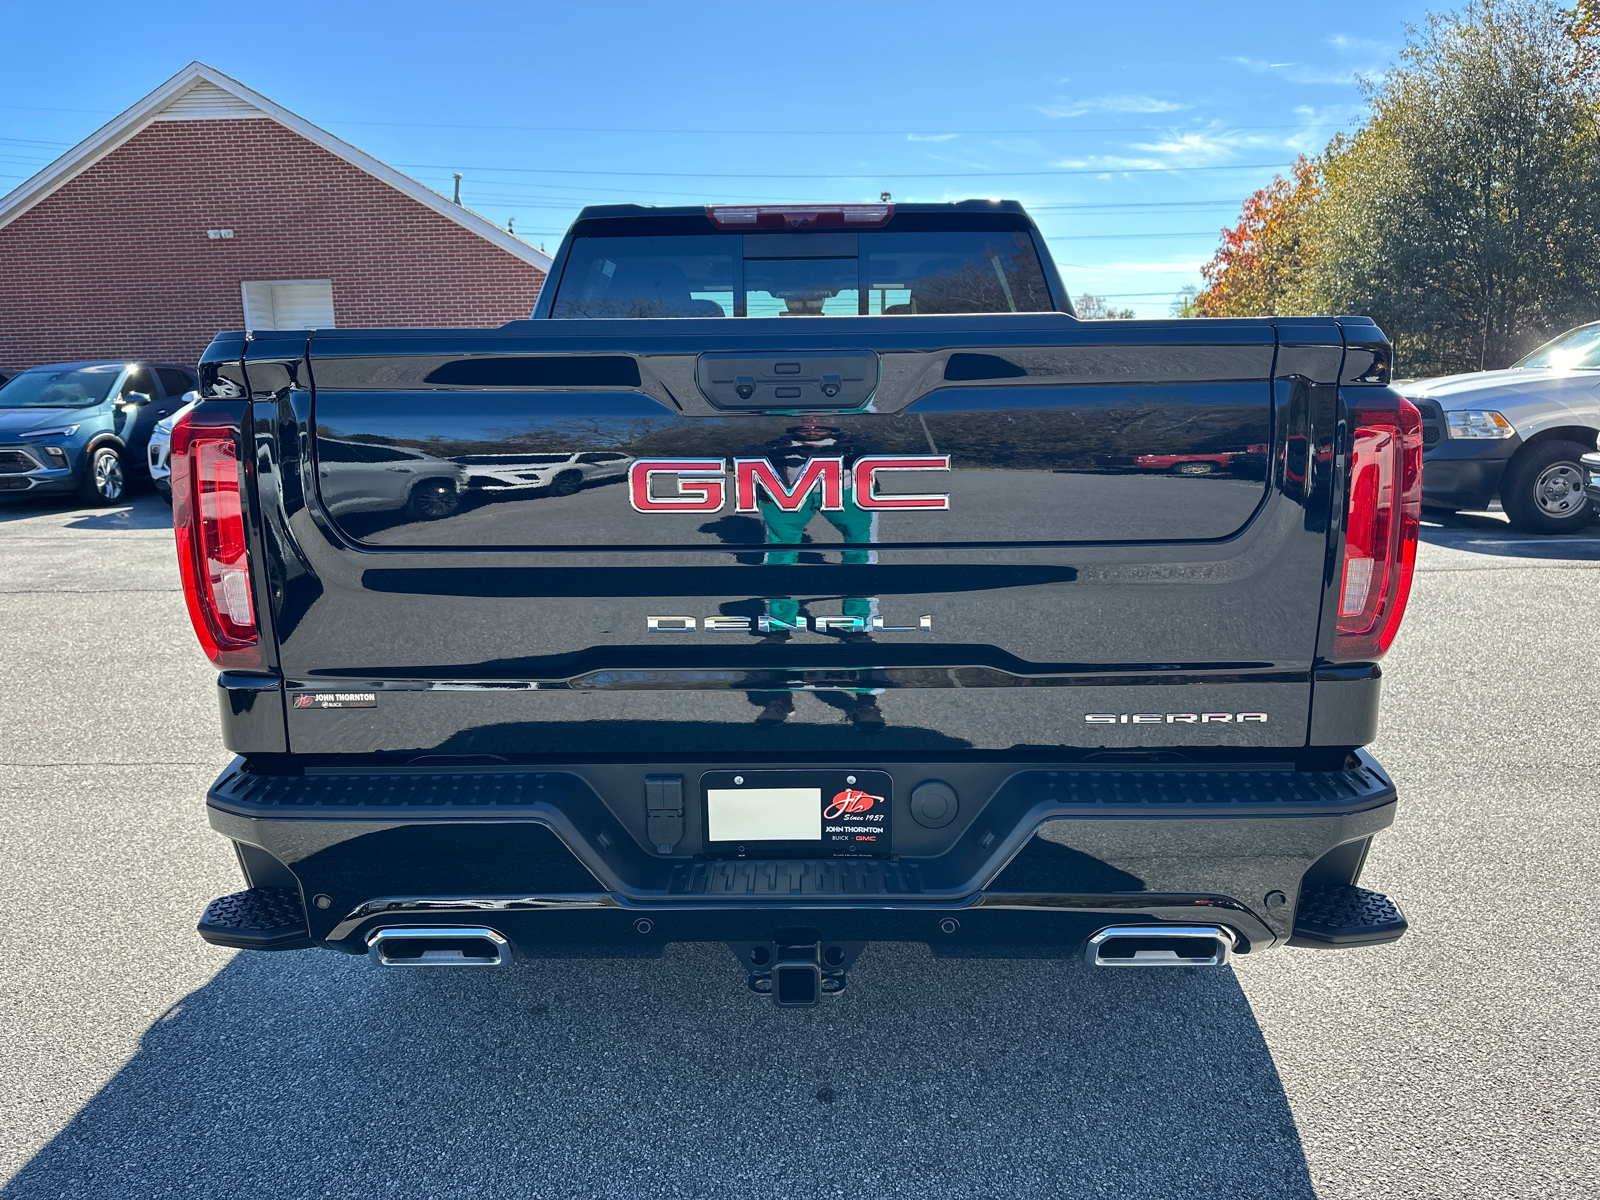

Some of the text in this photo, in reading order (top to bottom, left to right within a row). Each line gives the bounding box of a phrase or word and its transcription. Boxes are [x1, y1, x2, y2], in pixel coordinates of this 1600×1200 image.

[628, 454, 951, 514] GMC
[647, 615, 931, 633] DENALI
[315, 693, 375, 702] JOHN THORNTON
[1084, 712, 1268, 724] SIERRA
